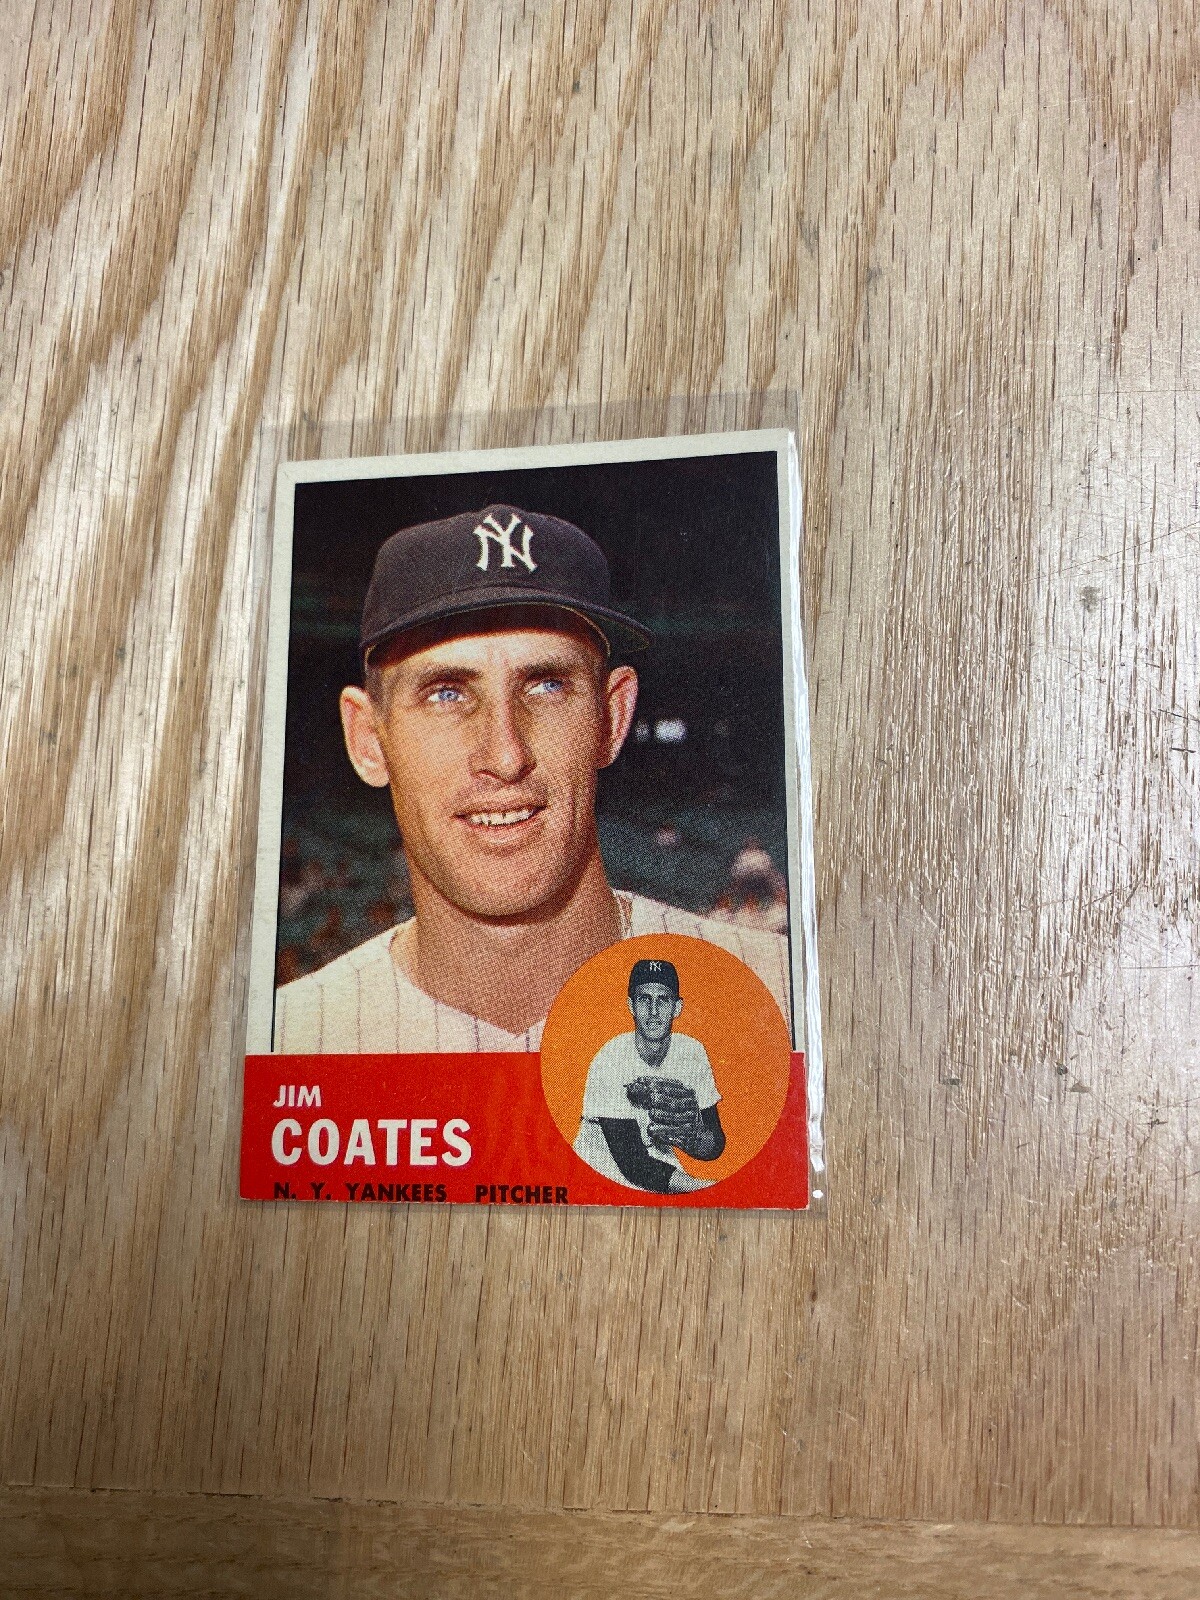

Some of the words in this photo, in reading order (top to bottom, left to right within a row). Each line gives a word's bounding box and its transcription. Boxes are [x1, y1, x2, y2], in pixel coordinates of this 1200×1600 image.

[273, 1085, 322, 1107] JIM
[271, 1118, 472, 1167] COATES
[273, 1182, 297, 1200] N.
[311, 1182, 331, 1201] Y.
[345, 1183, 447, 1203] YANKEES
[475, 1184, 569, 1204] PITCHER
